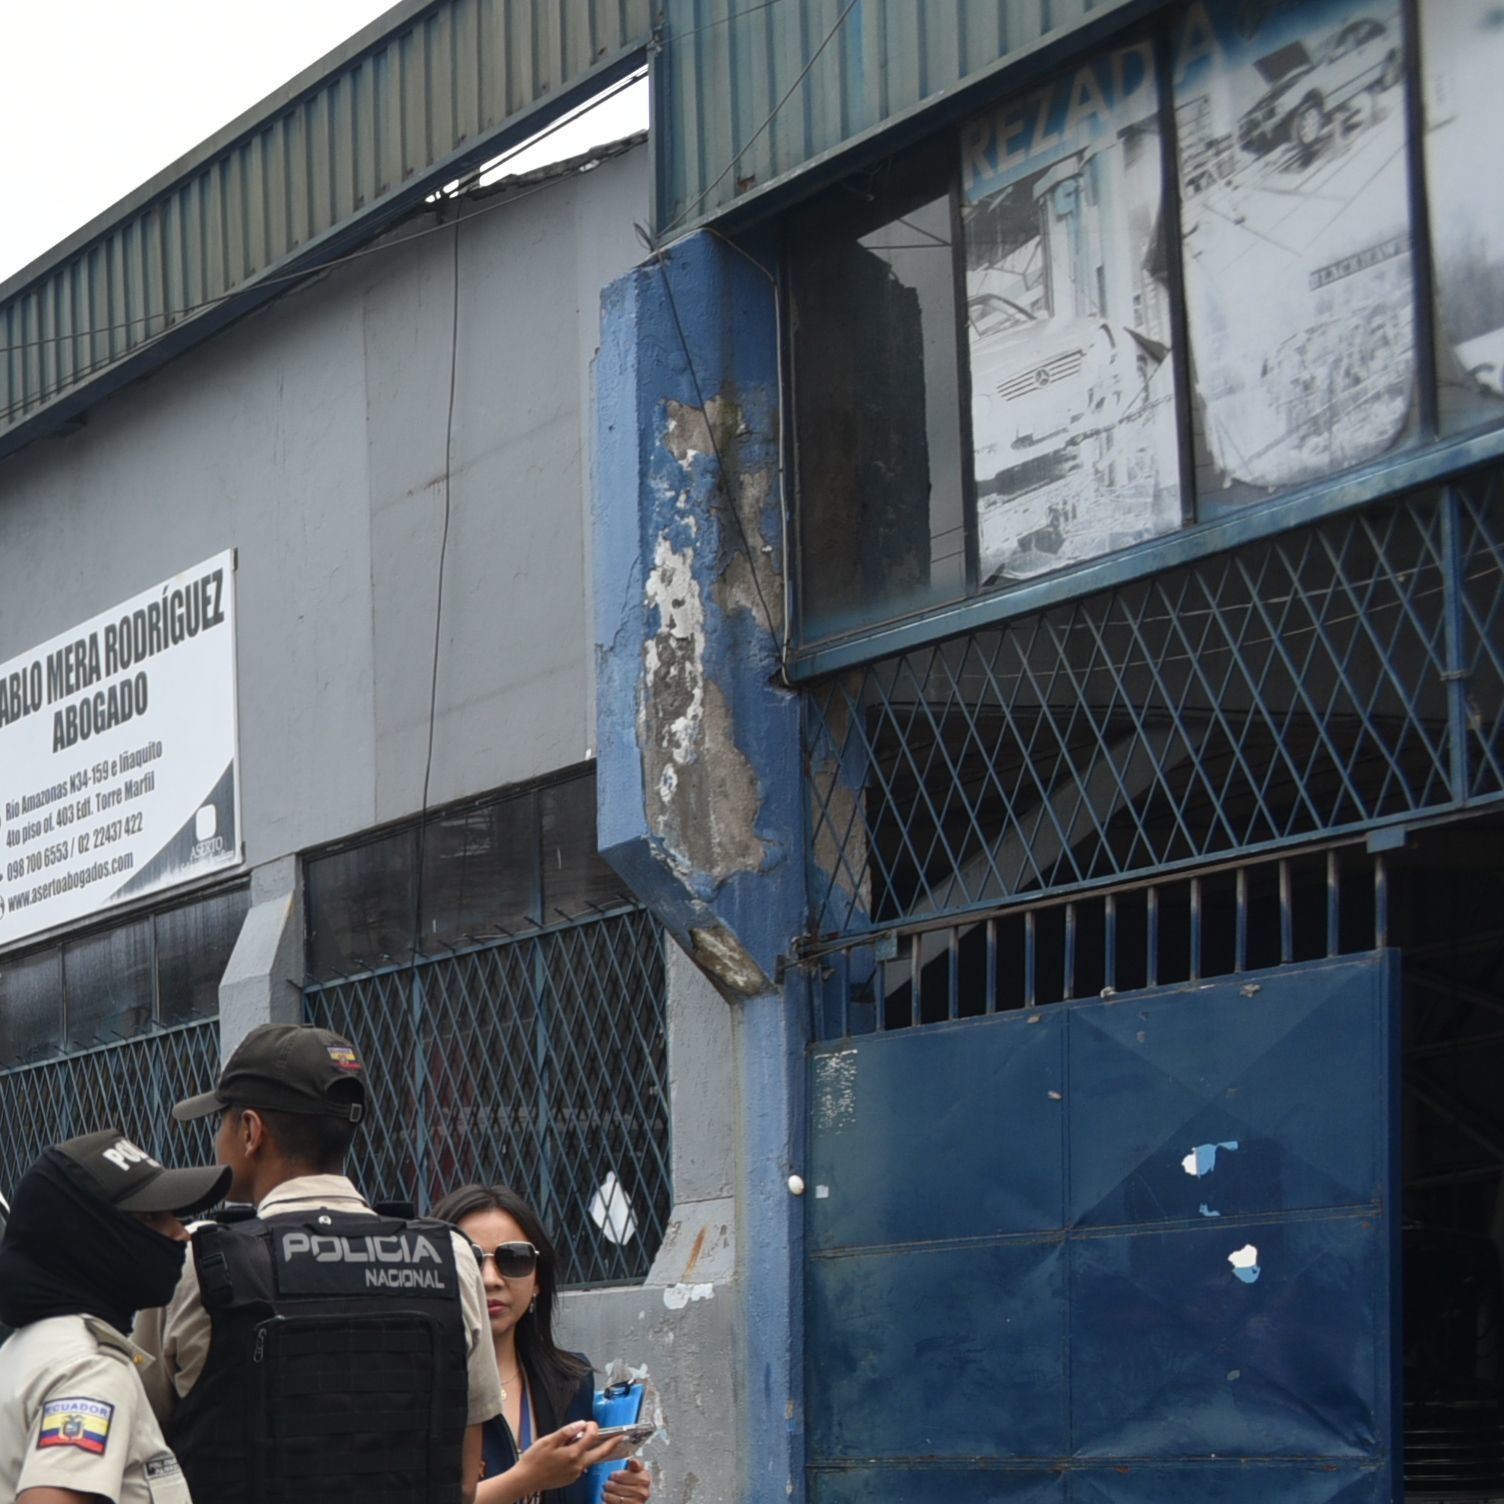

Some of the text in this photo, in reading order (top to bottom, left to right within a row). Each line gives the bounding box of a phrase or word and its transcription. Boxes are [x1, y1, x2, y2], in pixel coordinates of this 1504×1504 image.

[46, 631, 102, 705] MERA
[104, 567, 225, 679] RODRÍGUEZ
[52, 670, 148, 754] ABOGADO
[5, 828, 20, 848] 4to
[22, 822, 41, 845] piso
[56, 804, 74, 828] 403
[95, 787, 123, 813] Torre
[124, 770, 155, 801] Marfil
[21, 780, 68, 813] Amazonas
[69, 760, 109, 794] N34-159
[110, 760, 117, 777] e
[7, 857, 25, 882] 098
[26, 851, 42, 875] 700
[43, 840, 69, 868] 6553
[7, 851, 134, 912] www.asertoabogados.com
[282, 1232, 443, 1263] POLICIA
[365, 1268, 445, 1289] NACIONAL
[44, 1402, 109, 1417] ECUADOR
